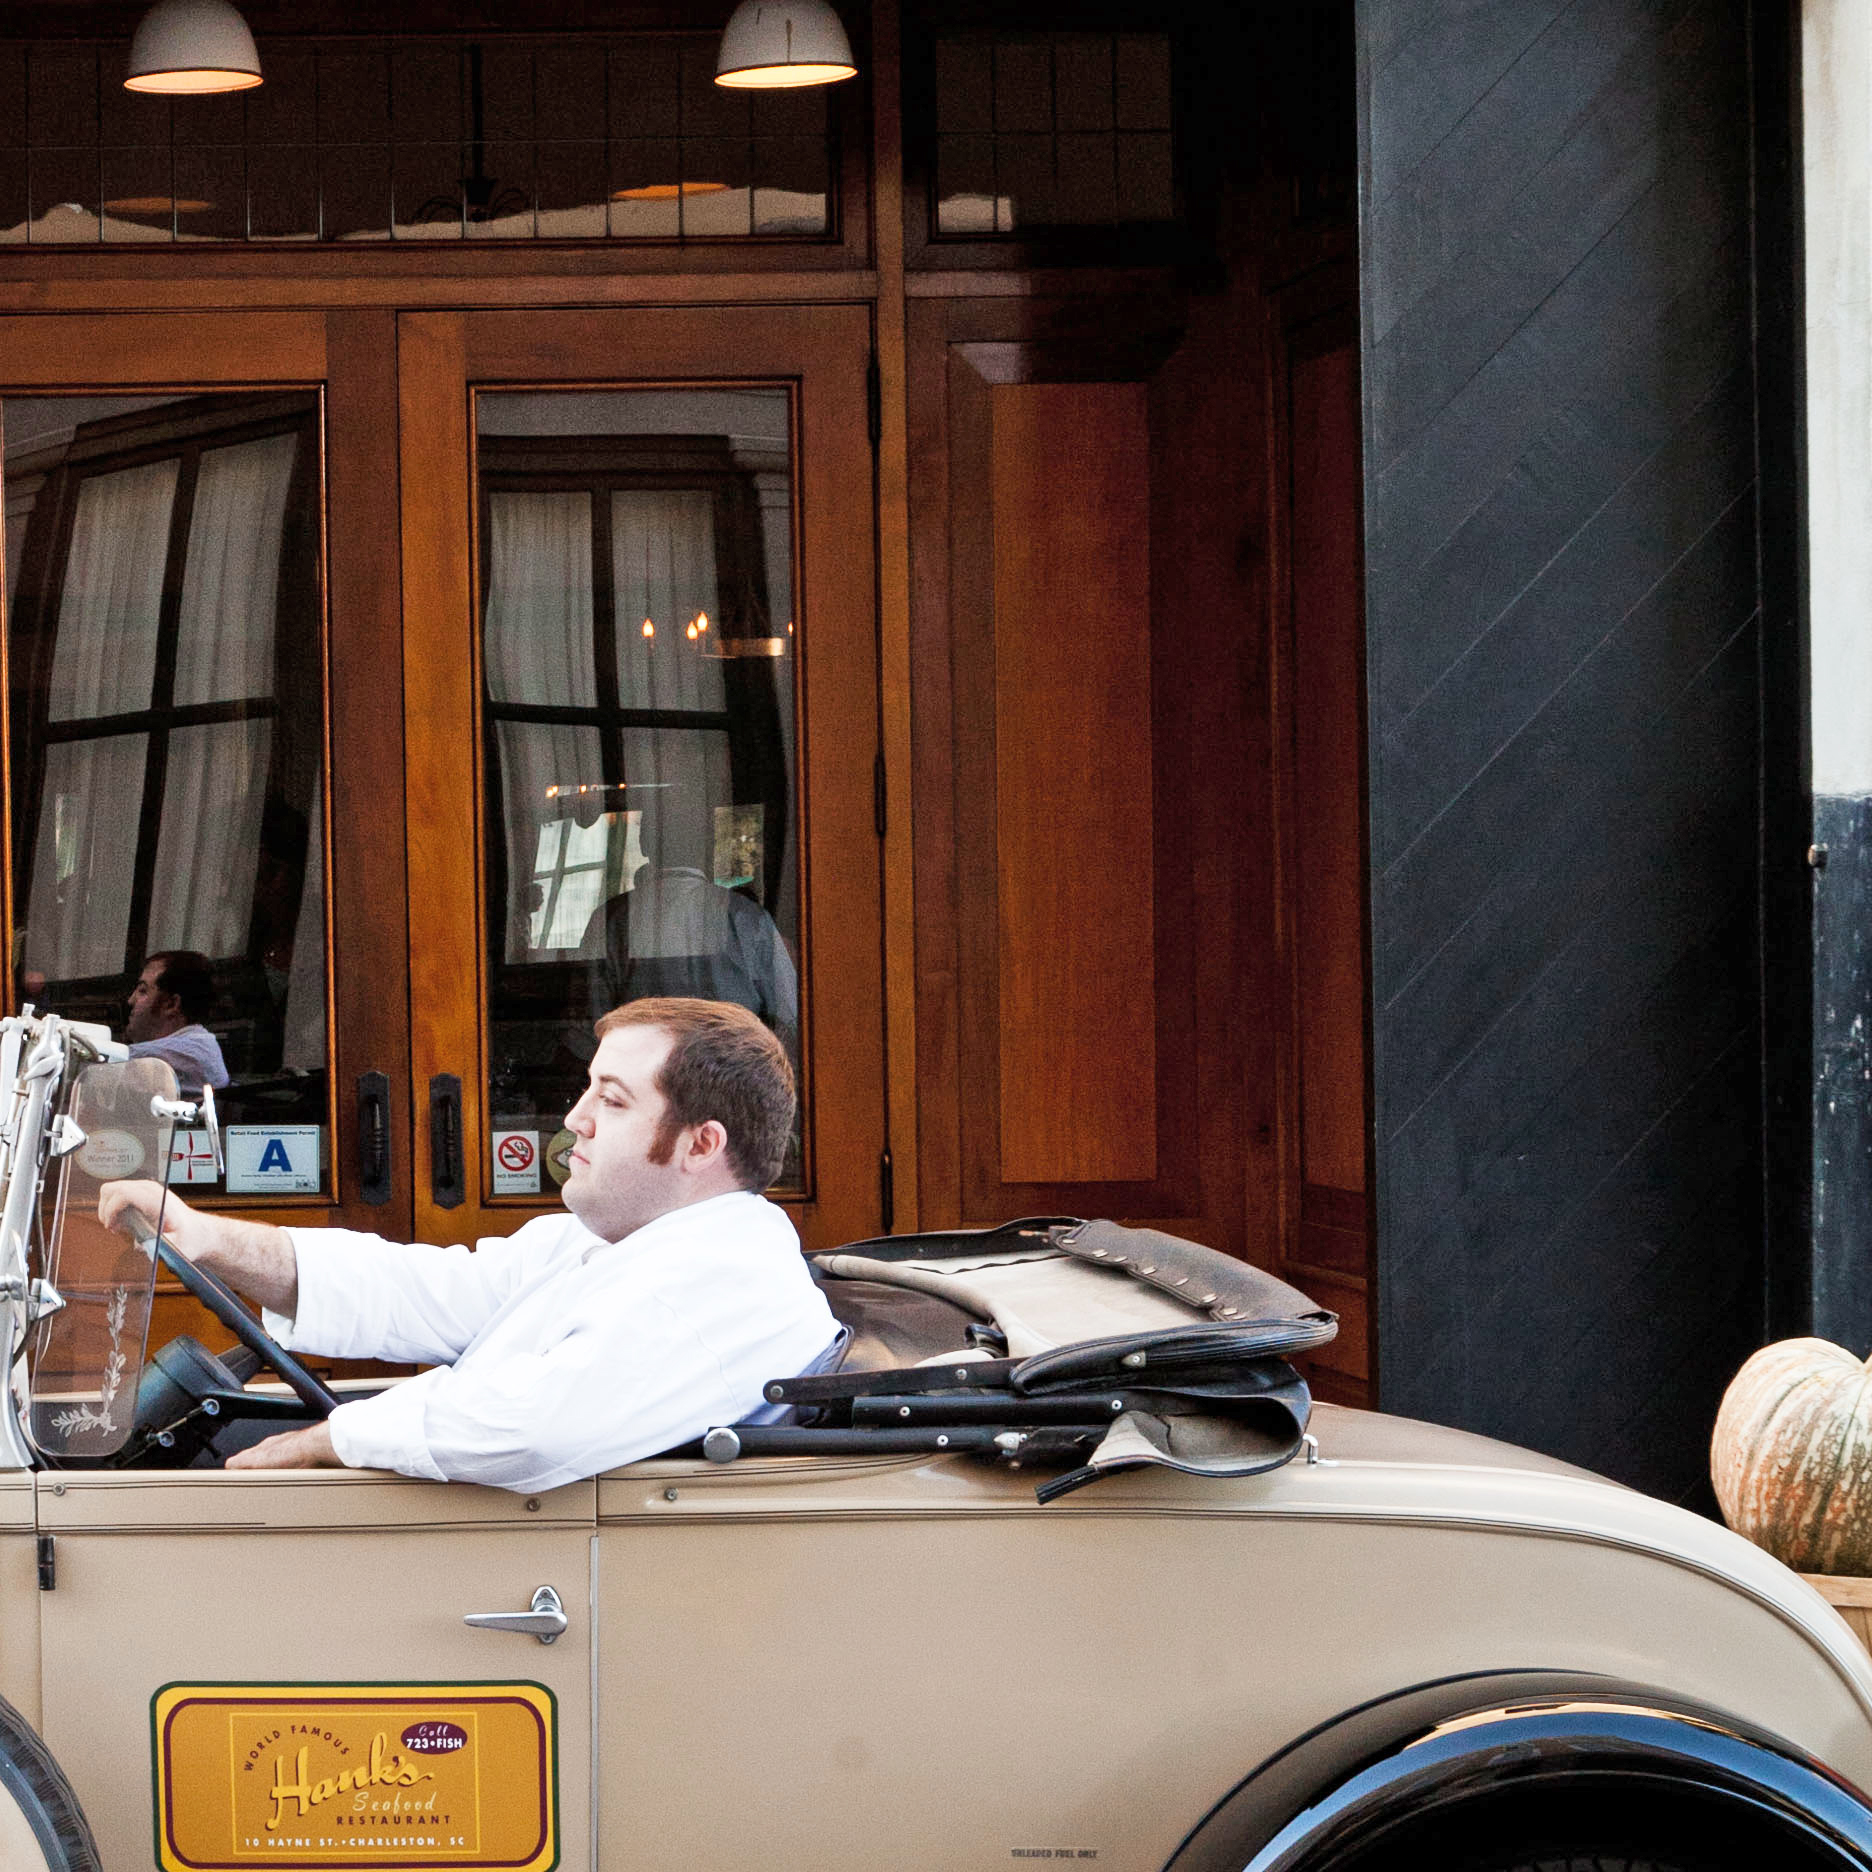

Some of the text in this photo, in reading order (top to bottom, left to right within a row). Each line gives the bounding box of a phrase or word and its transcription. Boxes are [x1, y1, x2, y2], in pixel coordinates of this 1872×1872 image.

[258, 1139, 292, 1172] A
[419, 1725, 448, 1736] Call
[243, 1725, 350, 1771] WORLD FAMOUS
[264, 1732, 435, 1832] Hank's
[352, 1791, 437, 1815] Seafood
[336, 1815, 451, 1825] RESTAURANT
[245, 1838, 260, 1847] 10
[268, 1838, 311, 1847] HAYNE
[449, 1836, 465, 1846] SC
[1011, 1849, 1097, 1858] UNLEADED FUEL ONLY
